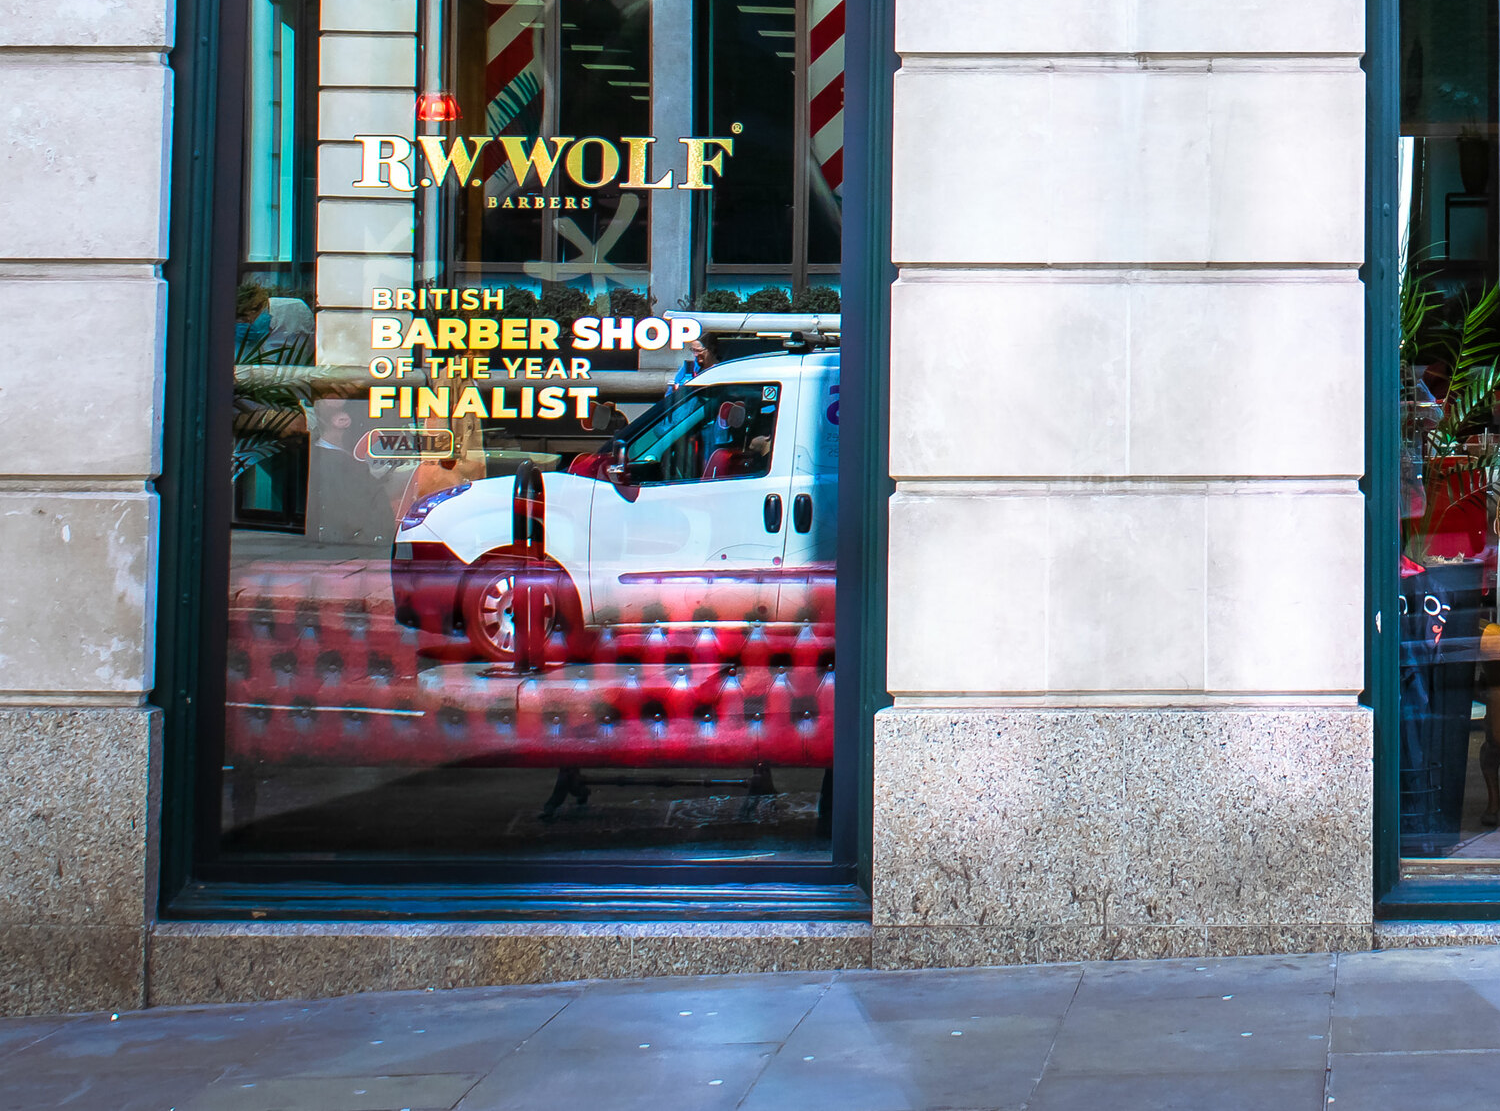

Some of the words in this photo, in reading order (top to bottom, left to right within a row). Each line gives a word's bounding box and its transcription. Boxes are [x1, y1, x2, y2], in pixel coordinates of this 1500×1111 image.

[498, 135, 733, 190] WOLF
[487, 196, 592, 210] BARBERS
[371, 287, 504, 310] BRITISH
[370, 317, 560, 350] BARBER
[571, 316, 702, 351] SHOP
[369, 356, 414, 379] OF
[425, 357, 490, 379] THE
[502, 357, 592, 379] YEAR
[368, 385, 599, 419] FINALIST
